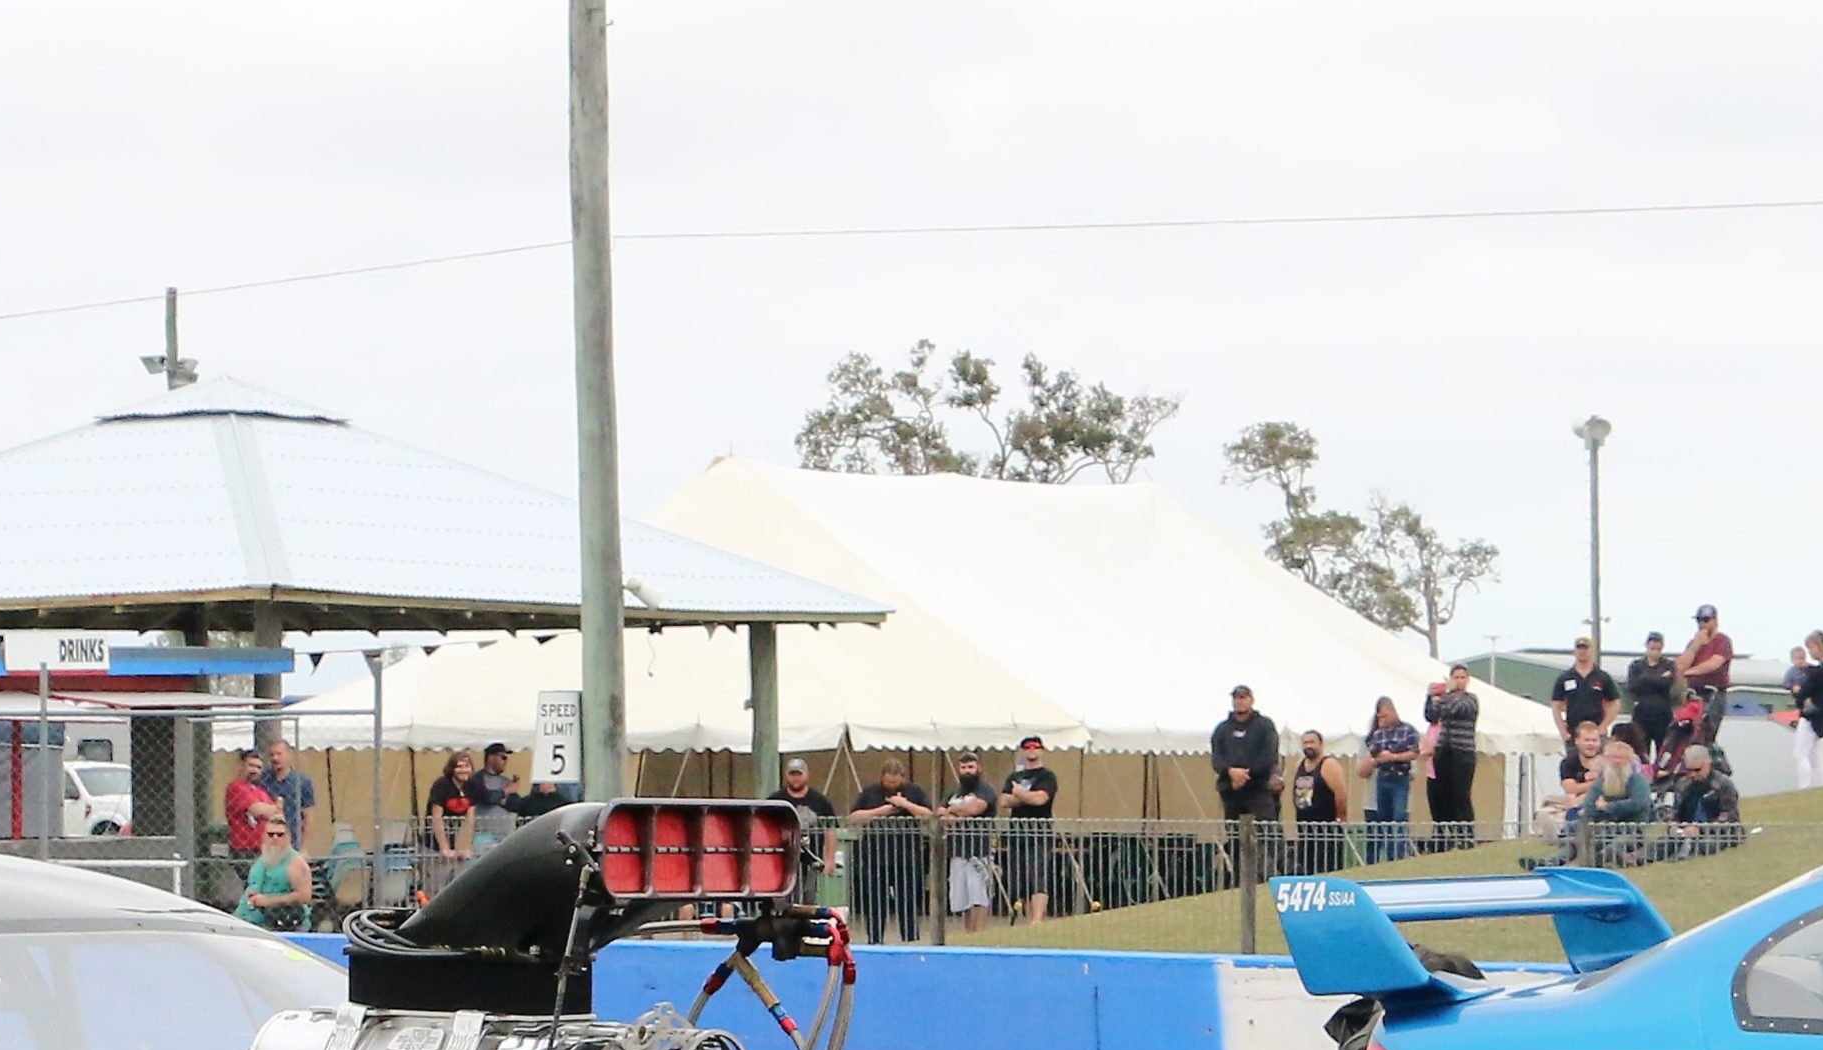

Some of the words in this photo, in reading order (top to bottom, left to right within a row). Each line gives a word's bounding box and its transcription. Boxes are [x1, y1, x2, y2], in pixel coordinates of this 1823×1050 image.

[59, 639, 105, 662] DRINKS
[540, 703, 577, 717] SPEED
[543, 722, 575, 736] LIMIT
[550, 744, 566, 775] 5
[1277, 881, 1327, 912] 5474
[1328, 891, 1356, 906] SS/AA
